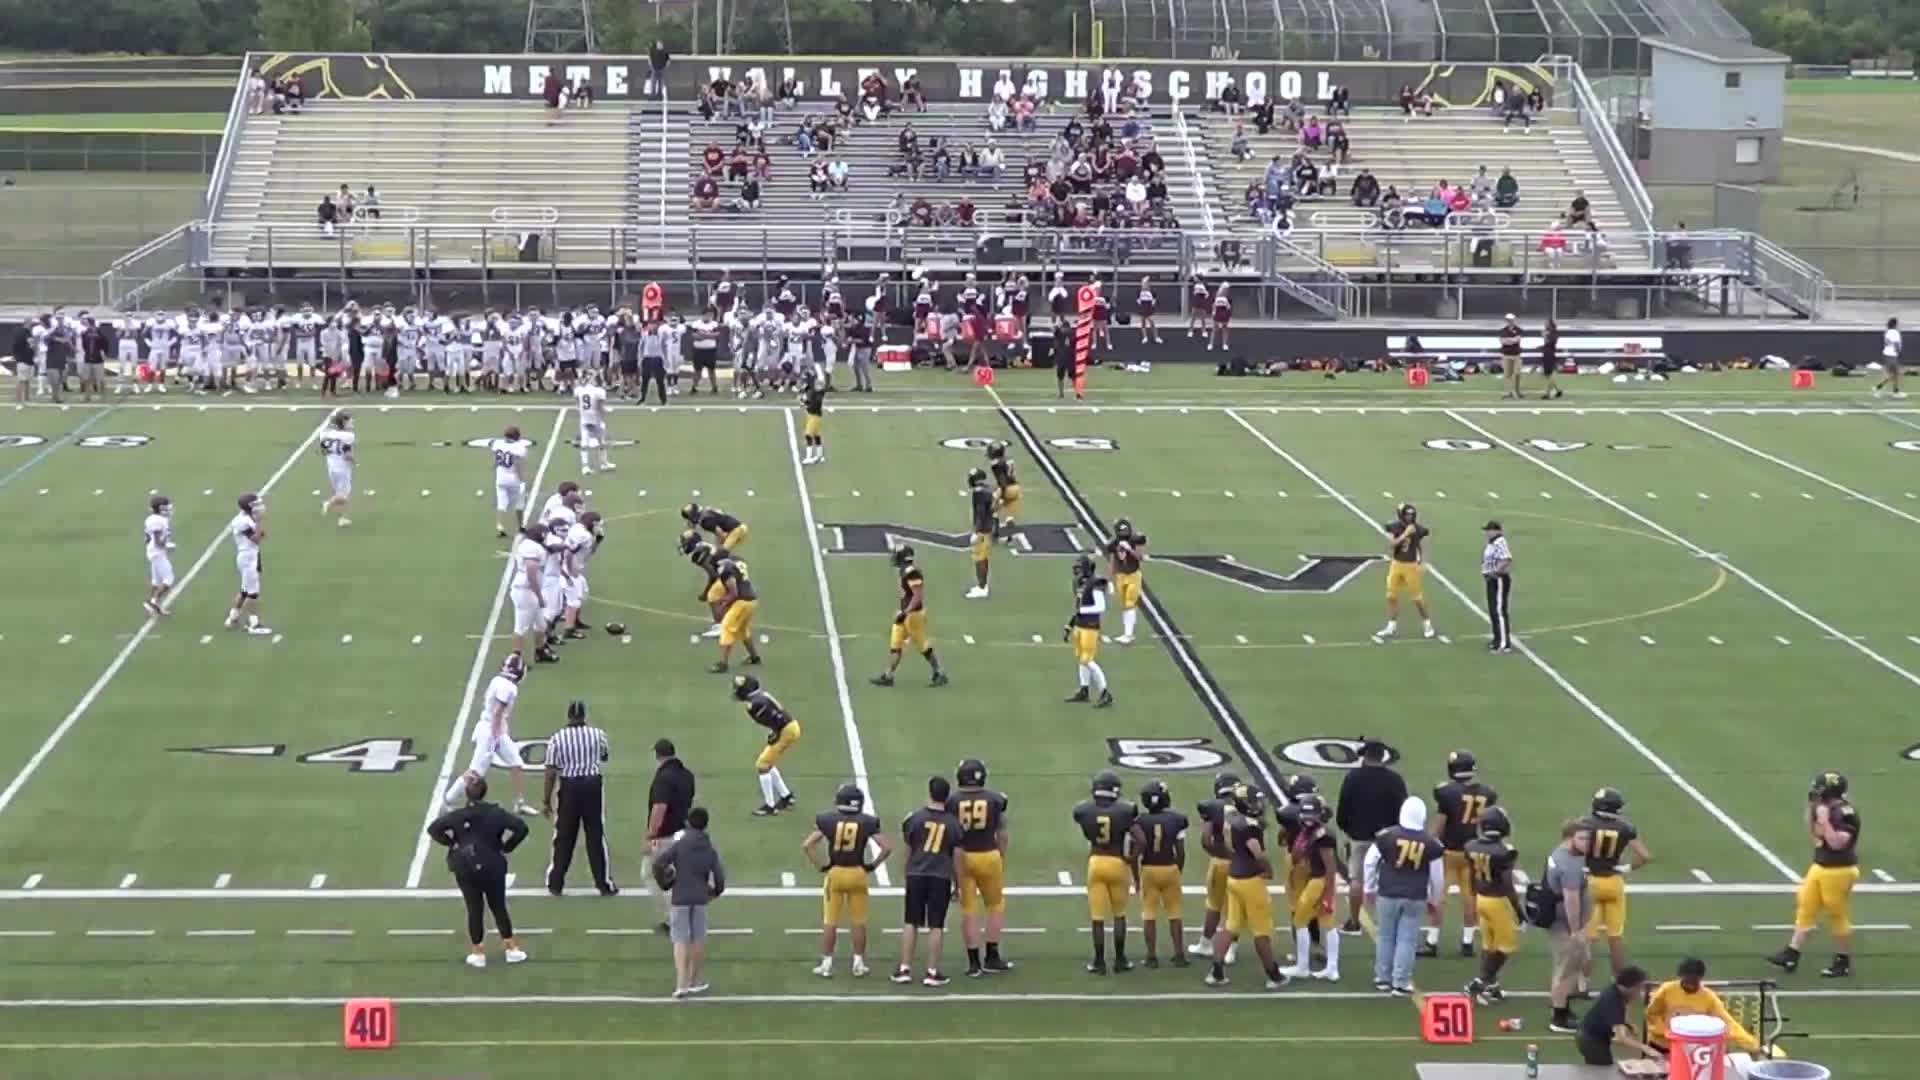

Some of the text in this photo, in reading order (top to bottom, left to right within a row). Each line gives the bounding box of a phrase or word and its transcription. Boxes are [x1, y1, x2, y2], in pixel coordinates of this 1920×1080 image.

[484, 65, 660, 95] METE
[1133, 70, 1337, 100] SCHOOL
[582, 394, 591, 410] 9
[834, 821, 859, 851] 19
[924, 821, 946, 853] 71
[1096, 816, 1111, 844] 3
[1153, 824, 1163, 852] 1
[1592, 829, 1619, 858] 17
[1395, 839, 1426, 870] 74
[350, 1007, 387, 1042] 40
[1432, 1003, 1469, 1037] 50
[1693, 1046, 1712, 1065] G
